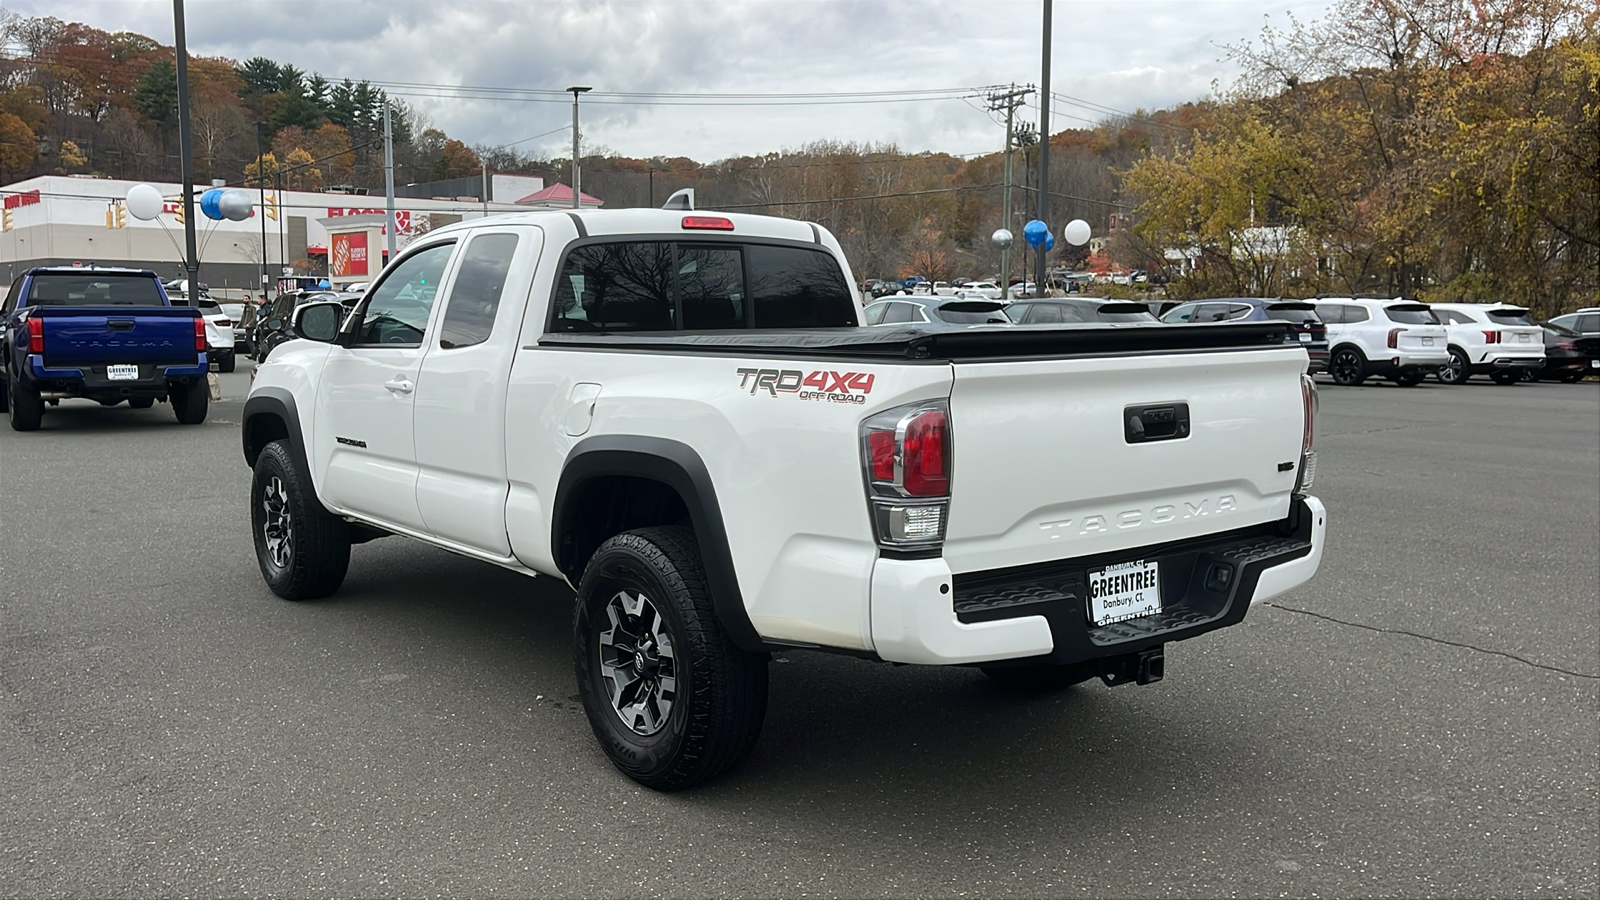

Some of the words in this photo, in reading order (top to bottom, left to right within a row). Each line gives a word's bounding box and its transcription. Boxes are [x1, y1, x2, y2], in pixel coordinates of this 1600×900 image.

[736, 368, 803, 398] TRD
[799, 391, 826, 401] OFF
[827, 393, 866, 404] ROAD
[1039, 494, 1237, 539] TACOMA
[1091, 569, 1156, 599] GREENTREE
[1103, 596, 1134, 609] Danbury,
[1135, 593, 1145, 603] CT.
[1098, 608, 1163, 627] GREENTREE
